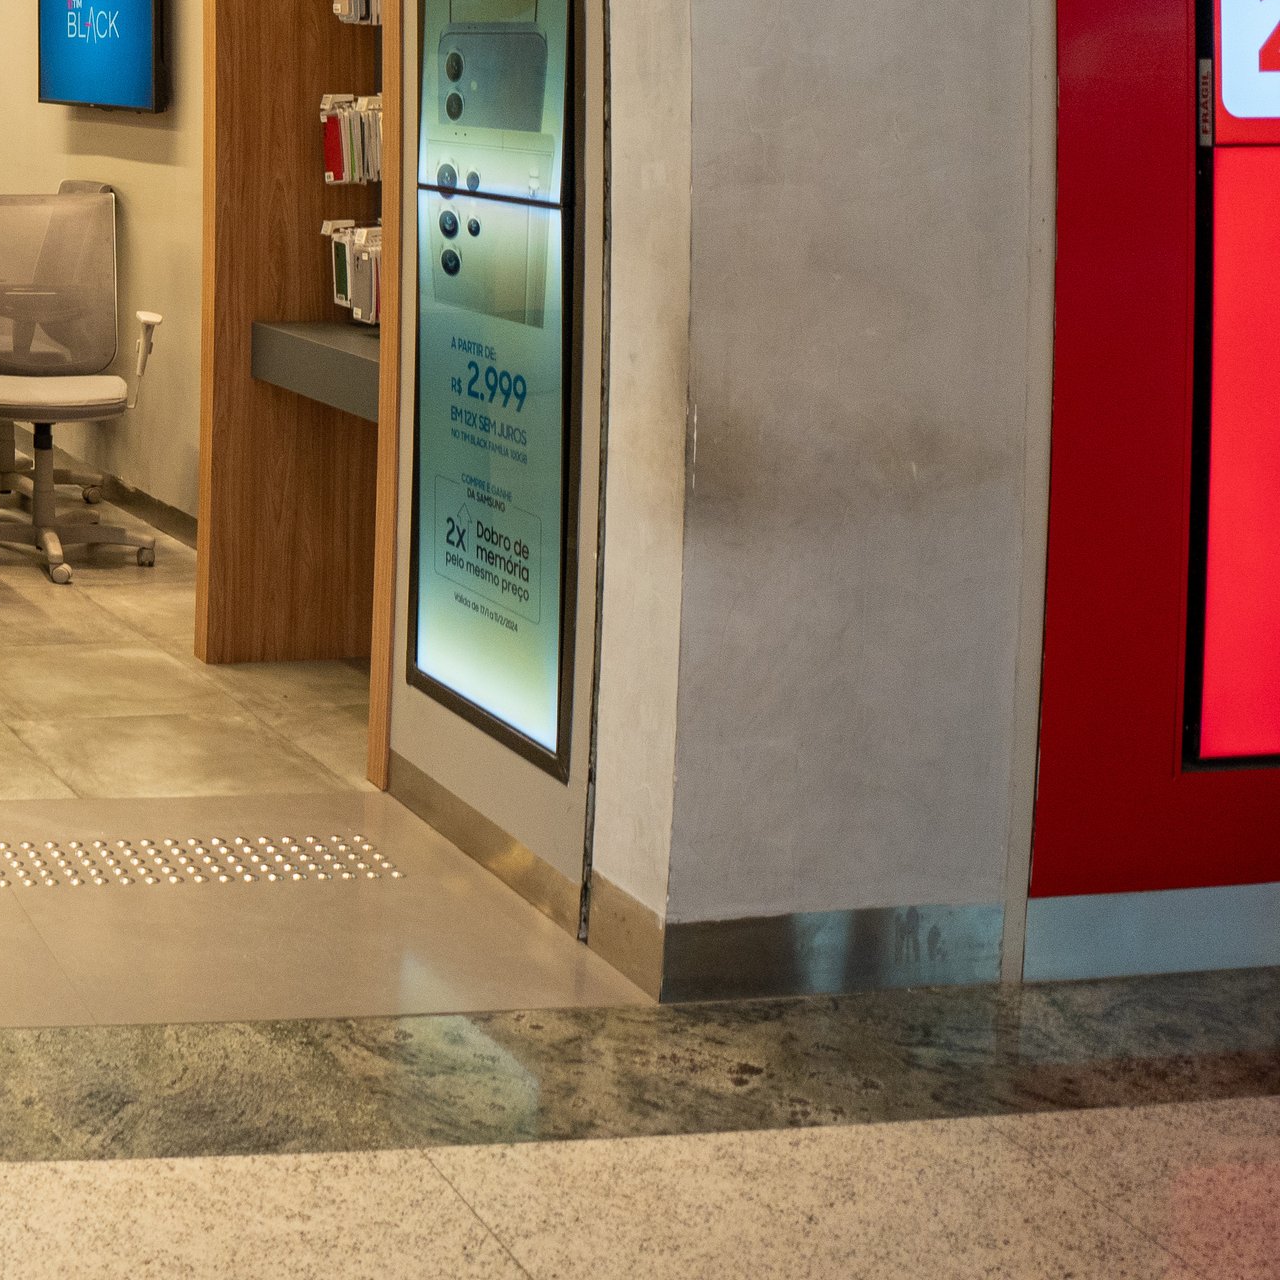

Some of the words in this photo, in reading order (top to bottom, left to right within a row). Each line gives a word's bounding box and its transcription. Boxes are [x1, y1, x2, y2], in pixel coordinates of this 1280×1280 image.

[67, 6, 120, 44] BLACK
[458, 338, 483, 359] PARTIR
[451, 377, 463, 396] R$
[467, 360, 527, 413] 2.999
[451, 405, 463, 423] EM
[464, 408, 478, 429] 12X
[479, 415, 496, 435] SEM
[497, 423, 528, 446] JUROS
[476, 519, 511, 552] Dobro
[514, 539, 530, 560] de
[445, 550, 465, 570] pelo
[466, 562, 500, 587] mesmo
[501, 576, 530, 603] preço
[476, 543, 530, 583] memória
